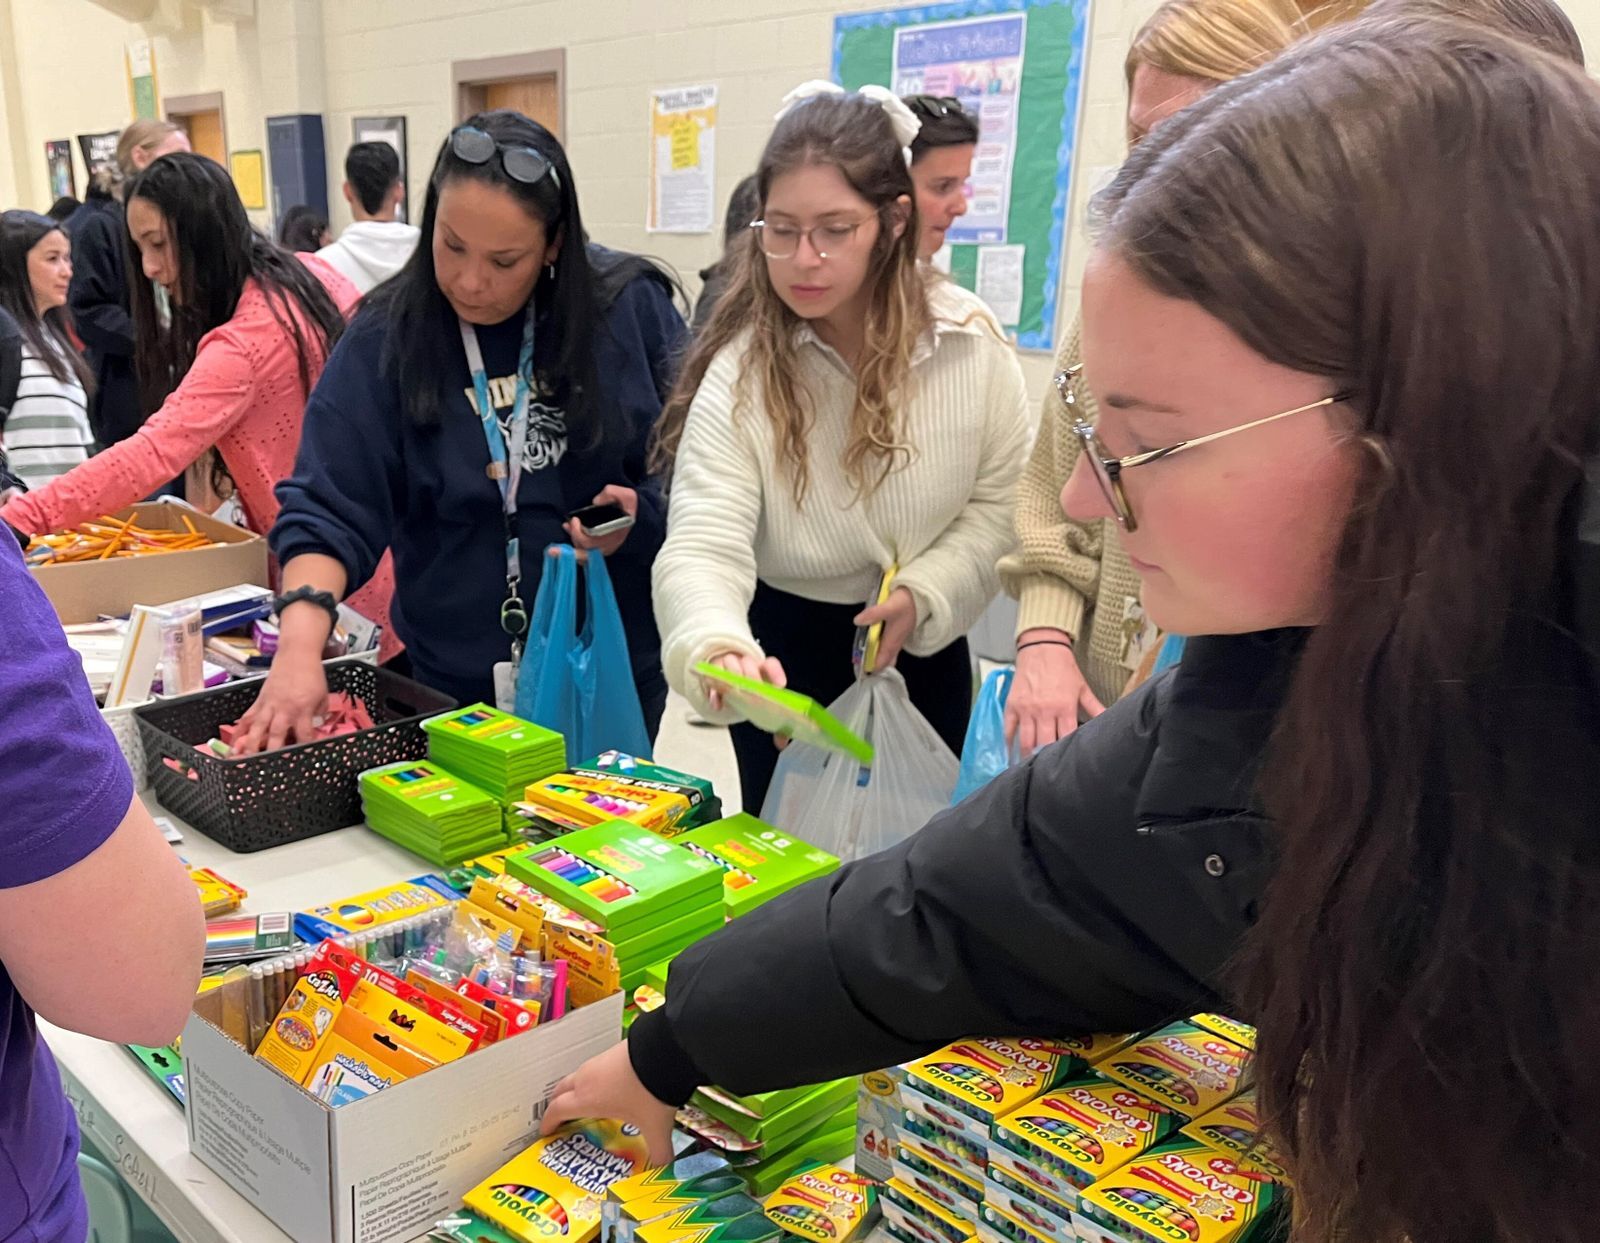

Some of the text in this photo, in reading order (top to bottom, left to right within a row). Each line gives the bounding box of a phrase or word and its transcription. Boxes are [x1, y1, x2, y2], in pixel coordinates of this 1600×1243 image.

[362, 968, 379, 987] 10
[458, 984, 468, 996] 6
[976, 1037, 1053, 1073] CRAYONS
[1020, 1039, 1042, 1050] 24
[1161, 1037, 1242, 1078] CRAYONS
[1205, 1042, 1225, 1054] 24
[927, 1067, 995, 1103] Crayola
[1115, 1066, 1189, 1106] Crayola
[1115, 1093, 1138, 1106] 24
[1068, 1087, 1153, 1133] CRAYONS
[567, 1132, 635, 1175] MARKERS
[1018, 1120, 1095, 1164] Crayola
[398, 1158, 414, 1173] Copy
[415, 1150, 433, 1164] Paper
[831, 1172, 849, 1184] 24
[1210, 1159, 1236, 1173] 24
[799, 1174, 865, 1204] CRAYONS
[1157, 1153, 1254, 1205] CRAYONS
[491, 1189, 560, 1237] Crayola
[769, 1210, 831, 1239] Crayola
[1104, 1190, 1190, 1241] Crayola
